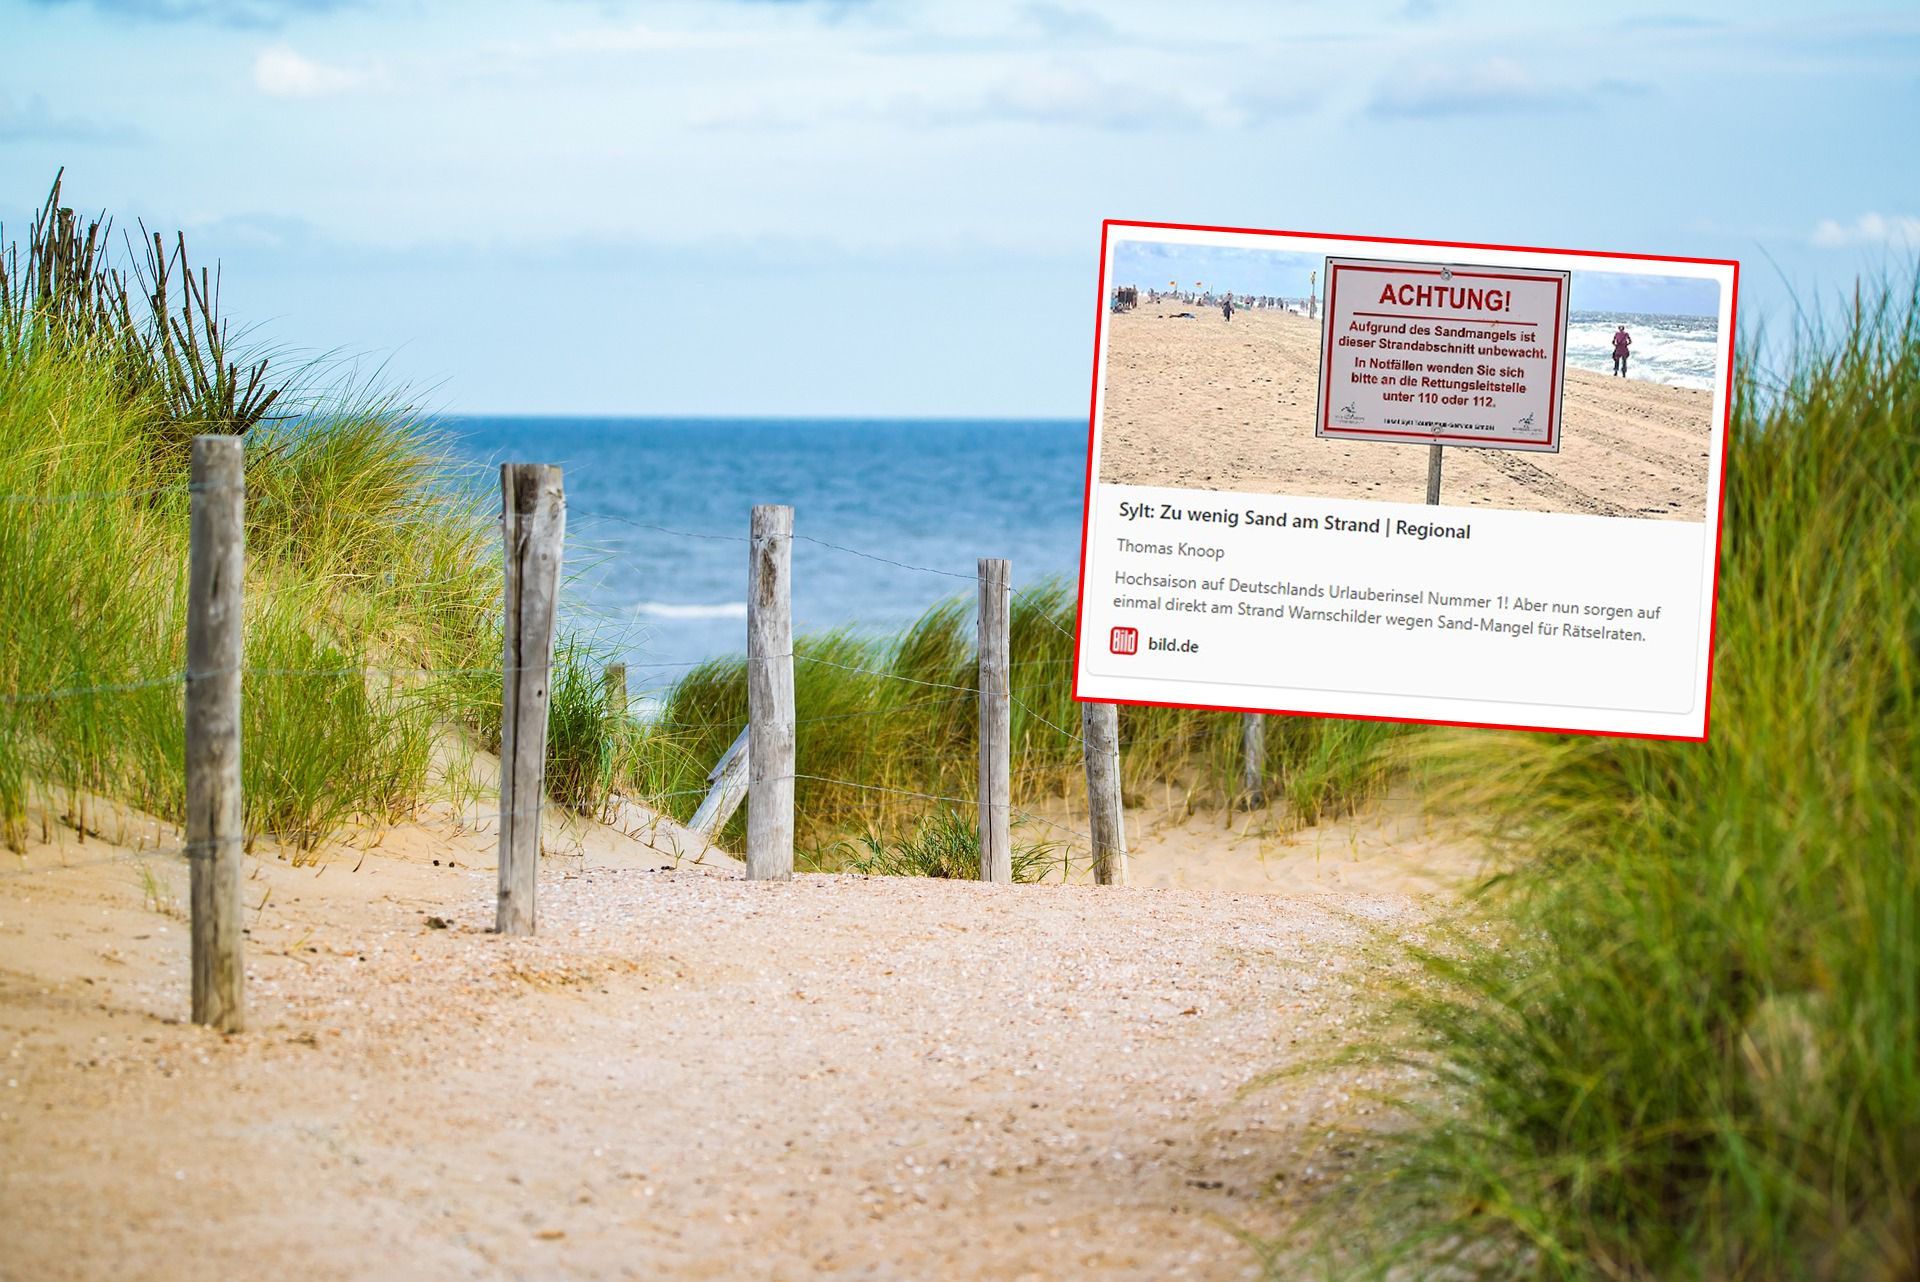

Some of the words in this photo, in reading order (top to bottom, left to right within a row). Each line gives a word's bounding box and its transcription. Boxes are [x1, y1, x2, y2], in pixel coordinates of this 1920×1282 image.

[1379, 284, 1510, 312] ACHTUNG!
[1349, 321, 1406, 335] Aufgrund
[1409, 324, 1430, 335] des
[1435, 326, 1516, 342] Sandmangels
[1521, 331, 1535, 342] ist
[1339, 336, 1376, 347] dieser
[1379, 338, 1474, 354] Strandabschnitt
[1478, 346, 1547, 359] unbewacht.
[1355, 357, 1365, 367] In
[1370, 358, 1422, 371] Notfällen
[1427, 364, 1473, 374] wenden
[1477, 365, 1495, 376] Sie
[1500, 367, 1524, 378] sich
[1351, 372, 1378, 384] bitte
[1381, 376, 1395, 385] an
[1400, 376, 1417, 386] die
[1421, 377, 1527, 393] Rettungsleitstelle
[1383, 392, 1415, 402] unter
[1419, 393, 1438, 404] 110
[1441, 395, 1469, 405] oder
[1473, 396, 1495, 407] 112.
